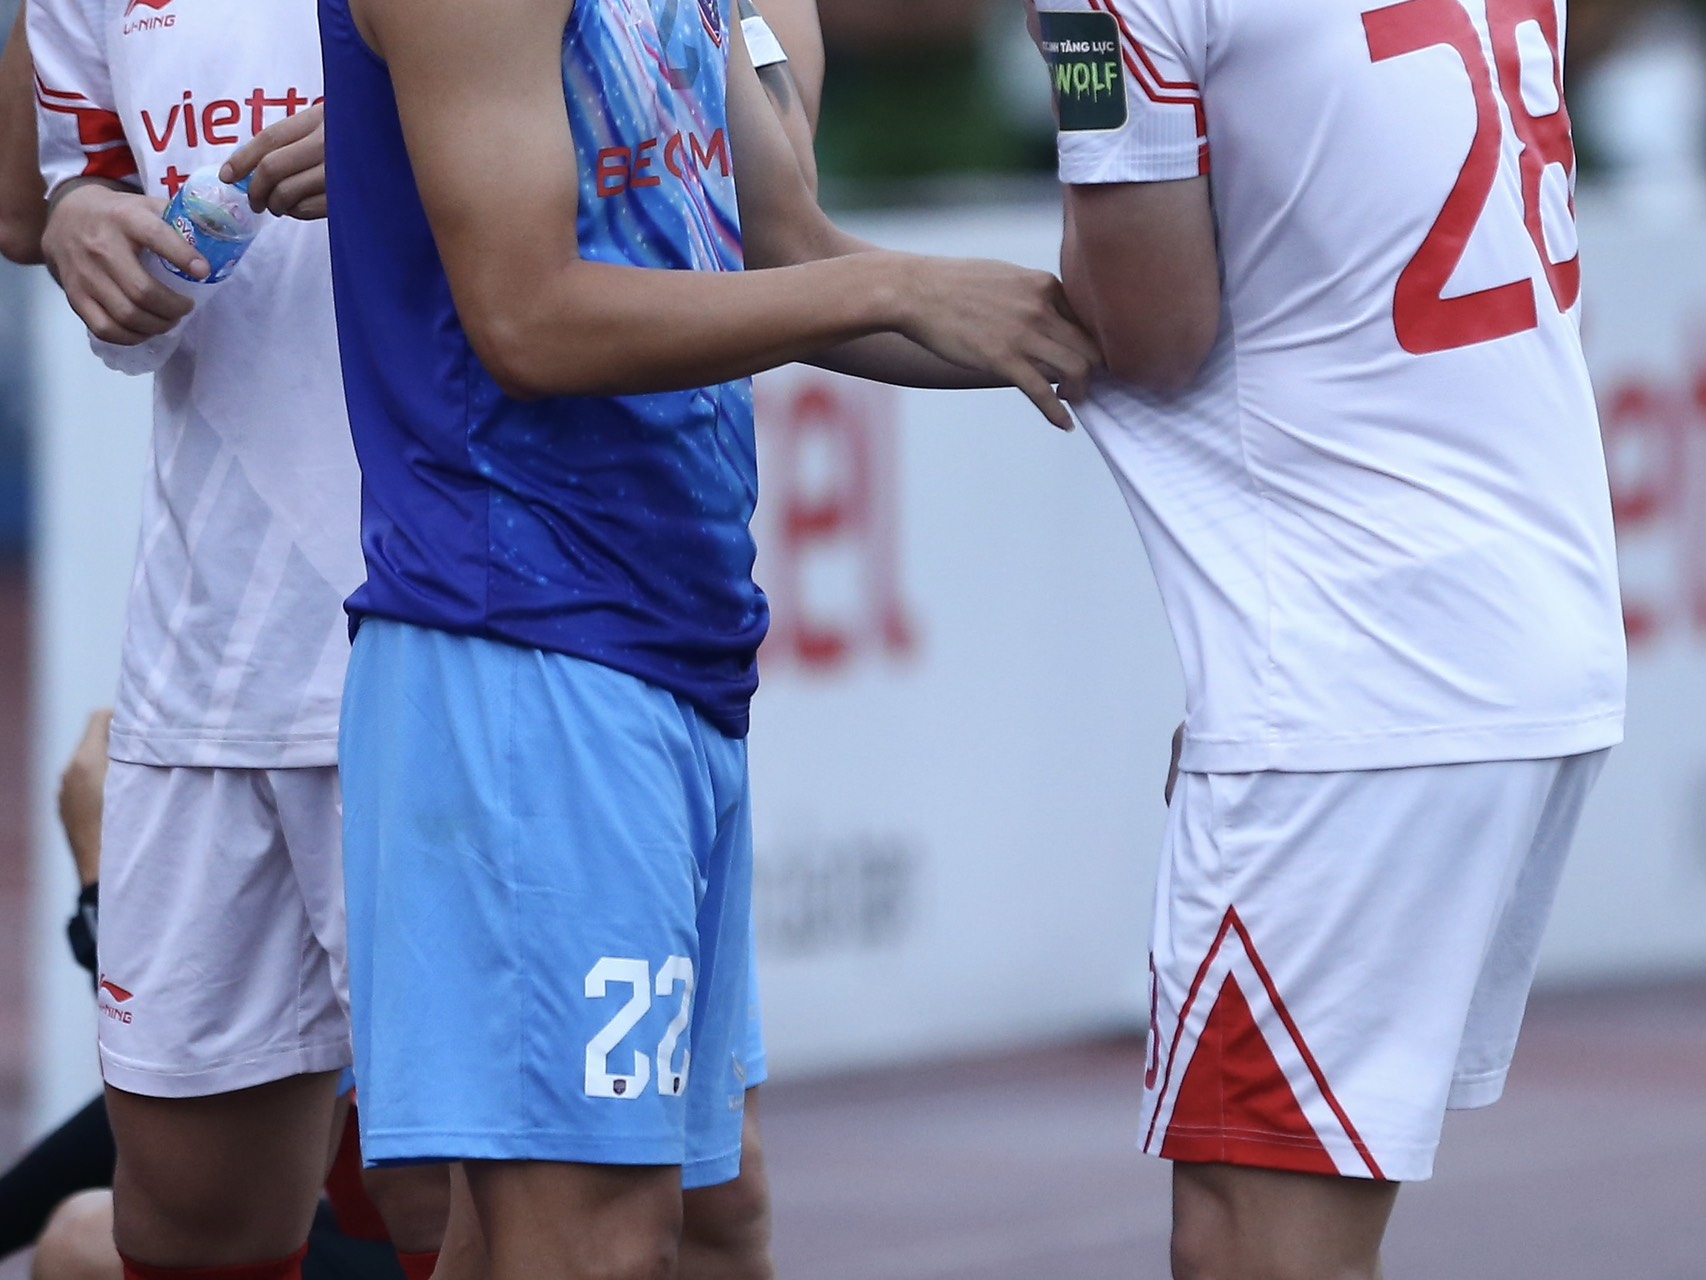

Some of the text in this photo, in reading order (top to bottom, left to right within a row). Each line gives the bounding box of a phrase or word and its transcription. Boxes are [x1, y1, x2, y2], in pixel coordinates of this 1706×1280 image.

[123, 14, 176, 35] LI-NING
[1060, 39, 1090, 53] TĂNG
[1093, 41, 1115, 55] LỰC
[1055, 61, 1118, 103] WOLF
[141, 87, 325, 153] viett
[98, 1003, 133, 1025] -NING
[584, 955, 694, 1100] 22
